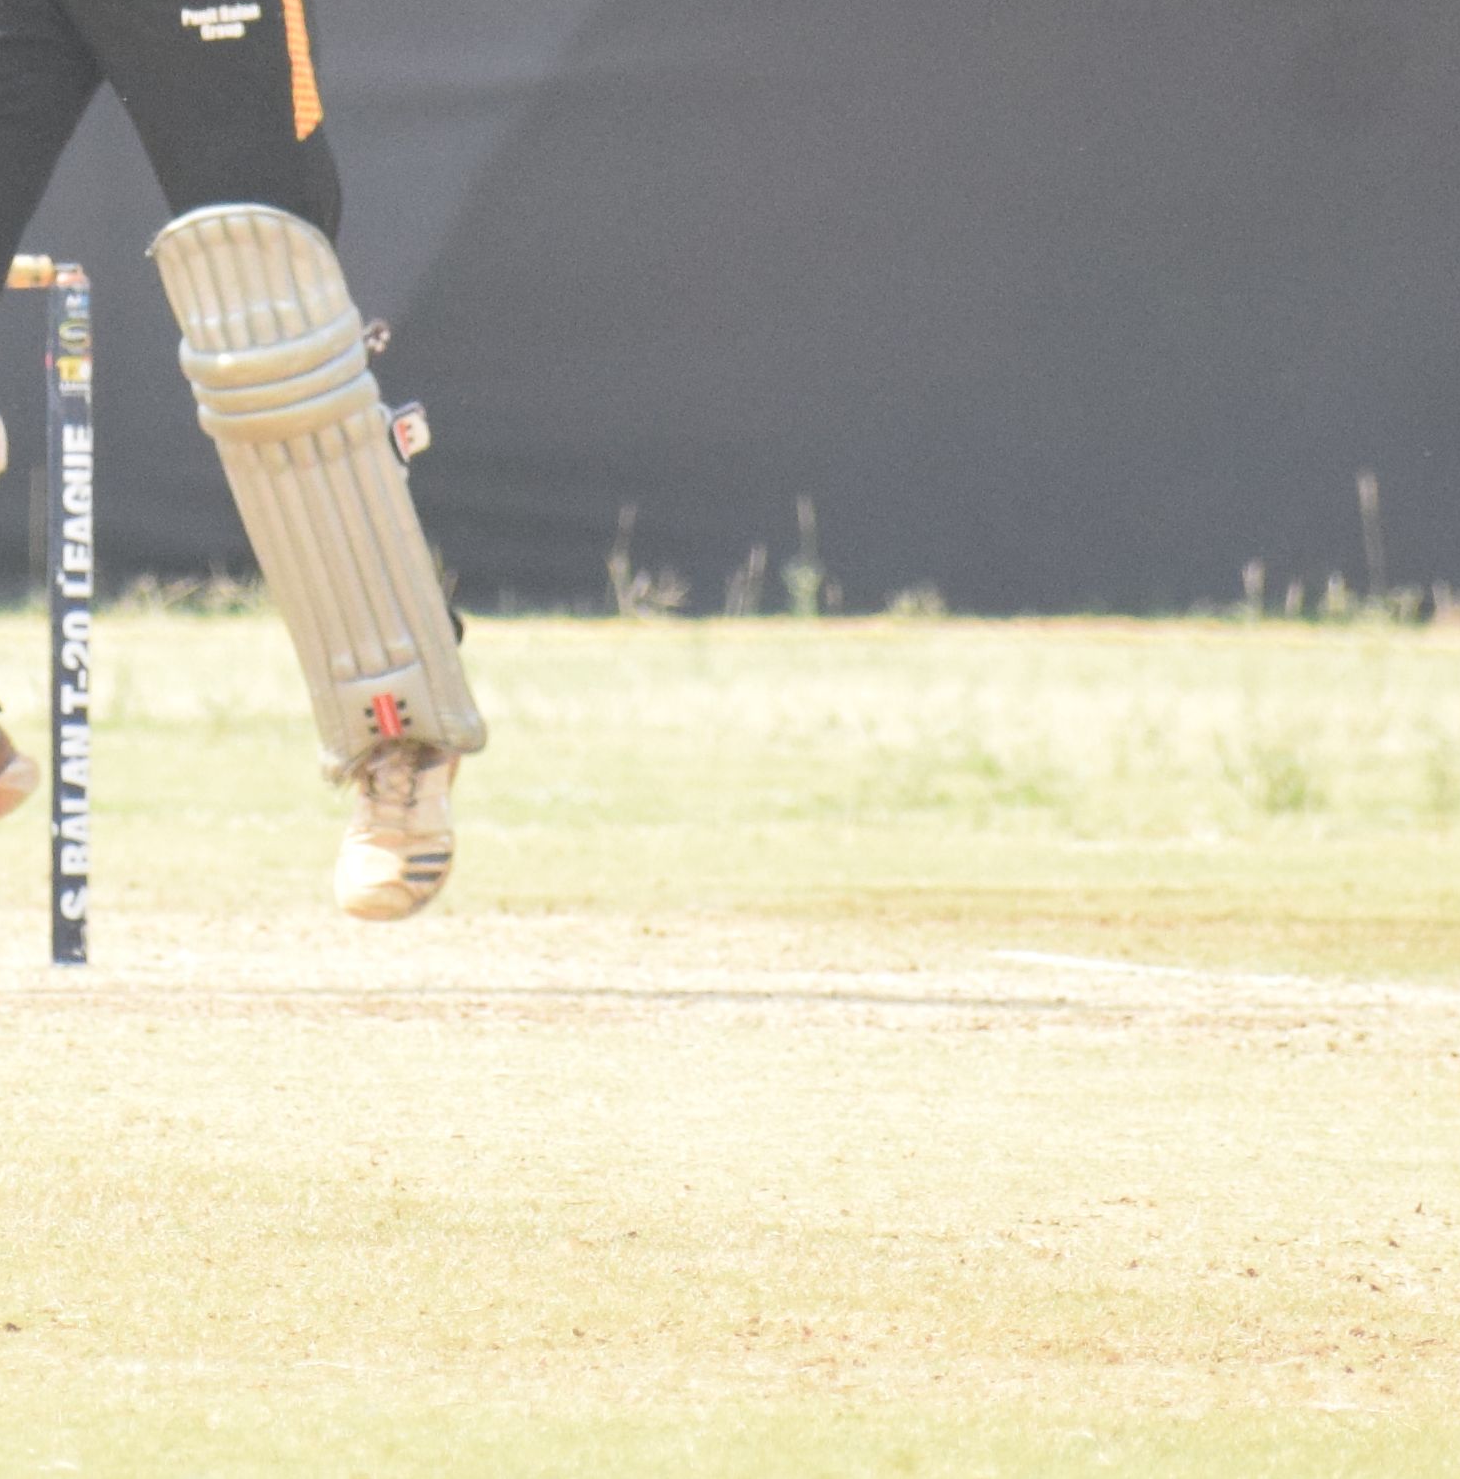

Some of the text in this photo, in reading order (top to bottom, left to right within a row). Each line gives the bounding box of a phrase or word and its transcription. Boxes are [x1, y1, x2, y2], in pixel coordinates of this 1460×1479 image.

[62, 424, 94, 598] LEAGUE
[60, 610, 92, 716] T-20
[60, 723, 90, 876] BALAN
[60, 885, 88, 921] S
